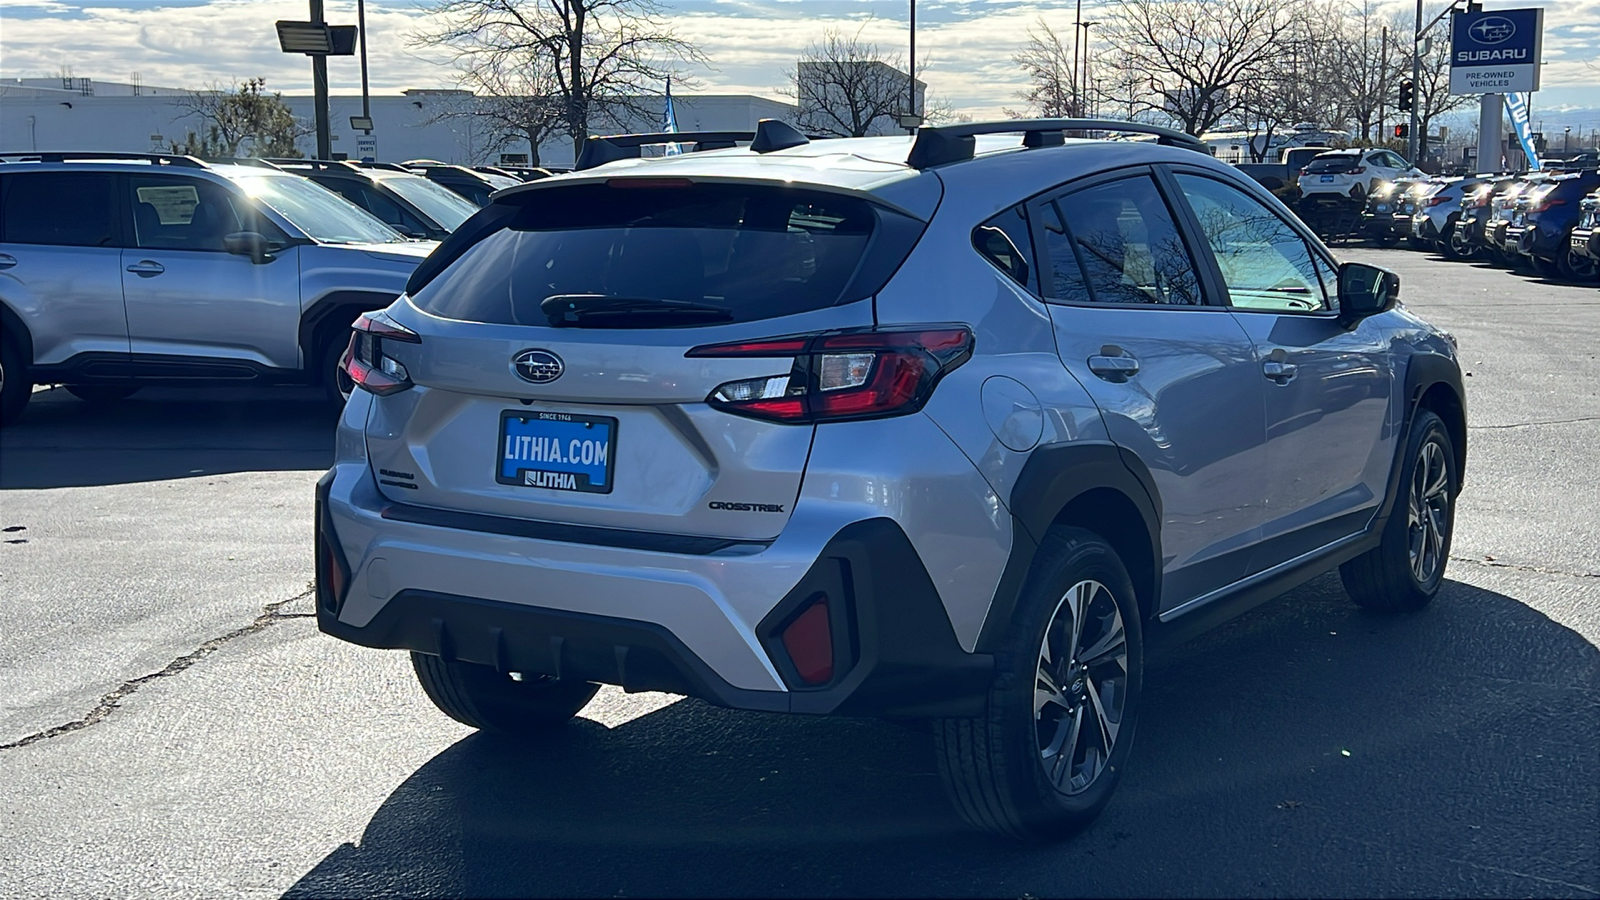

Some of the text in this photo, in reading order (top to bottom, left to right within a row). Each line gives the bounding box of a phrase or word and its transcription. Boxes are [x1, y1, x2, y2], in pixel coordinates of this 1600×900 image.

[1457, 48, 1527, 61] SUBARU
[1465, 71, 1515, 79] PRE-OWNED
[1469, 80, 1510, 88] VEHICLES
[539, 412, 572, 422] SINCE 1946
[504, 434, 609, 467] LITHIA.COM
[536, 471, 577, 490] LITHIA
[708, 501, 785, 513] CROSSTREK
